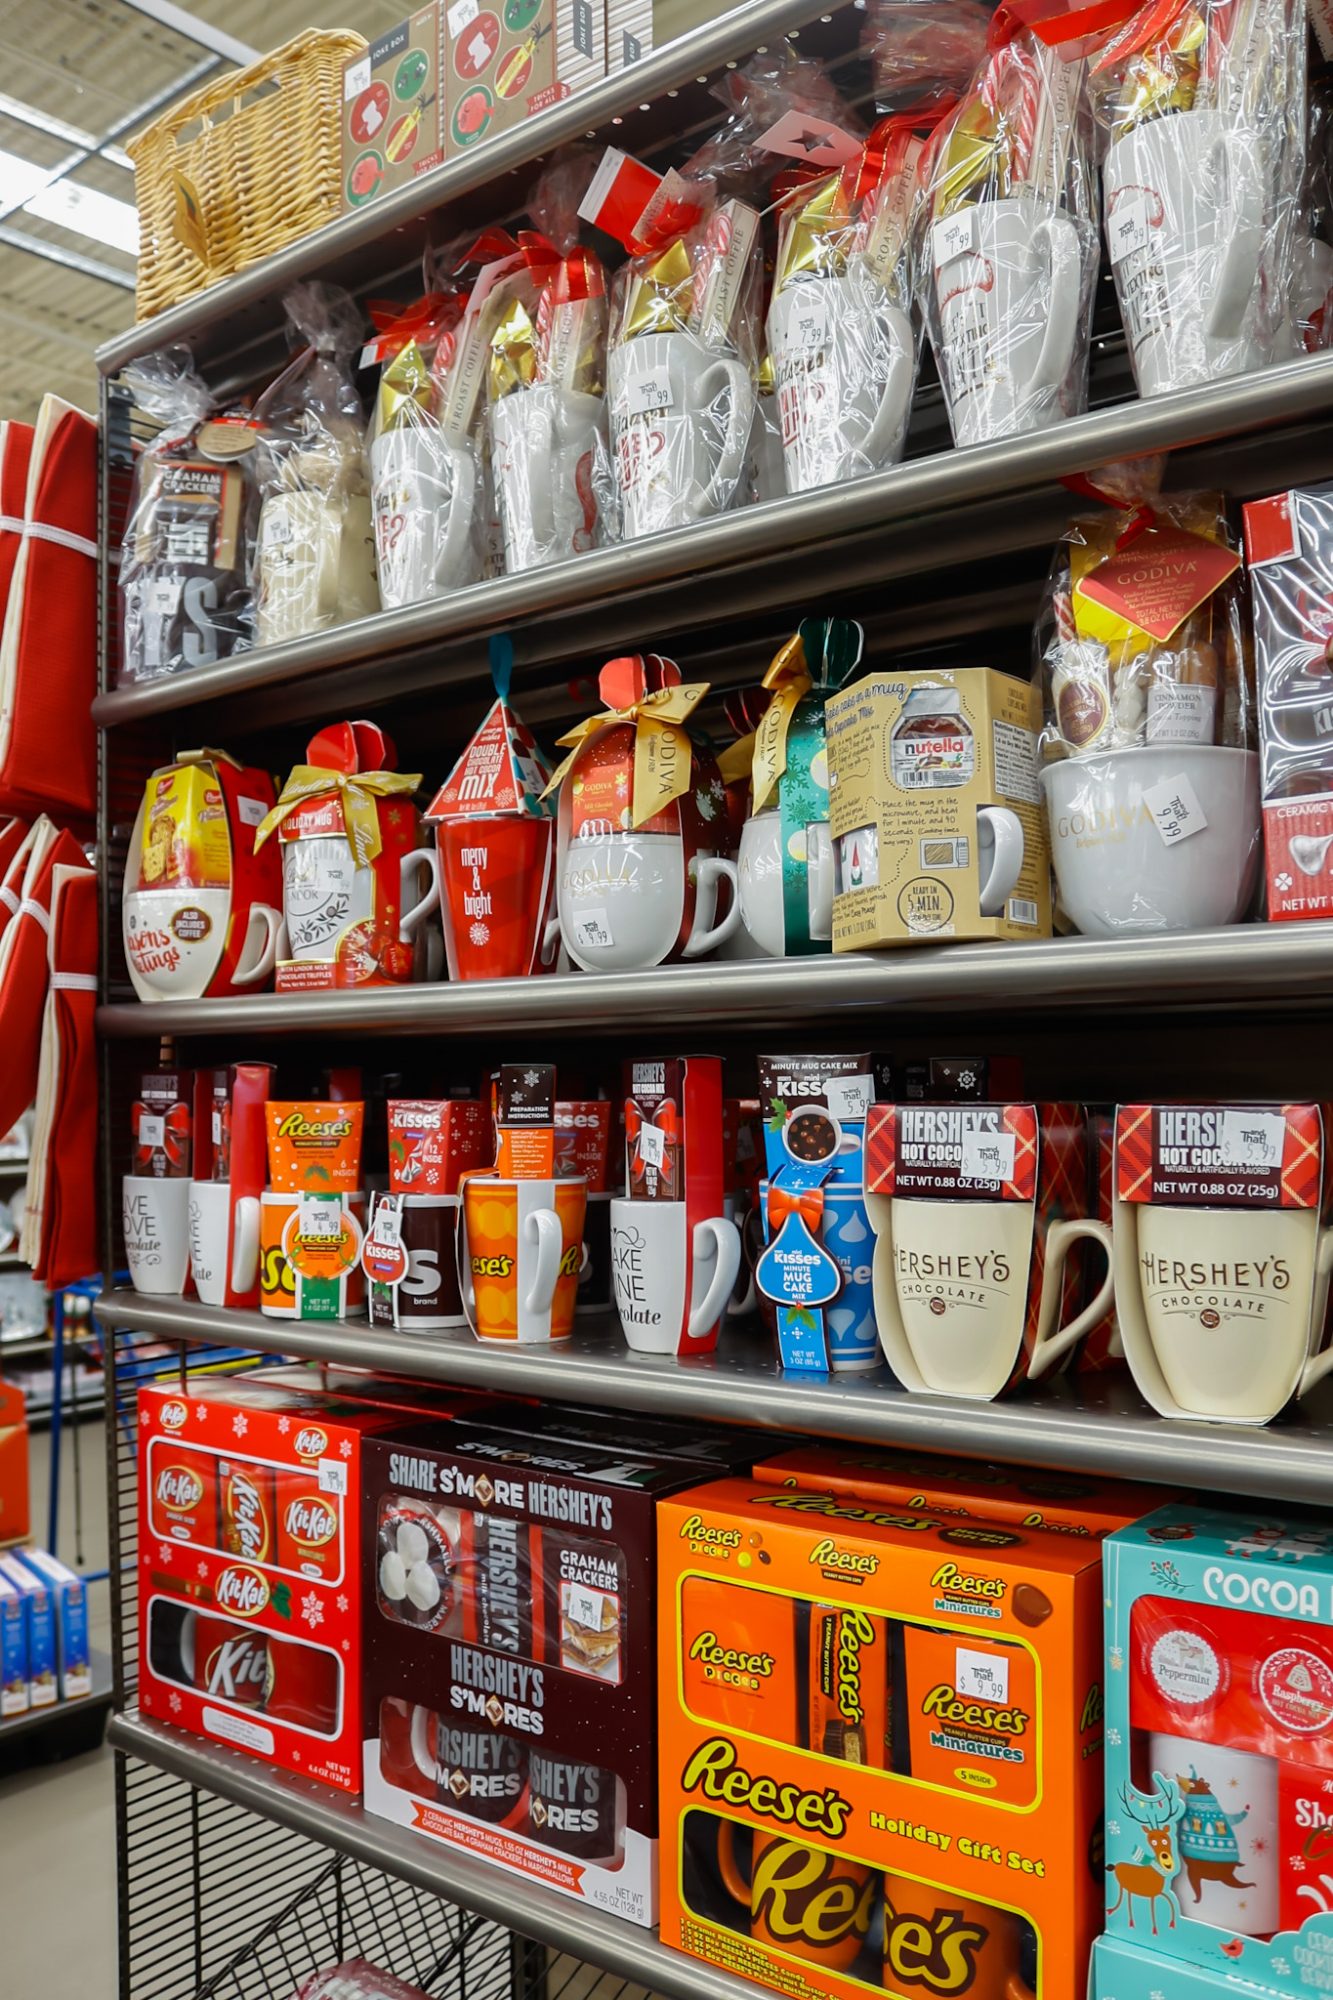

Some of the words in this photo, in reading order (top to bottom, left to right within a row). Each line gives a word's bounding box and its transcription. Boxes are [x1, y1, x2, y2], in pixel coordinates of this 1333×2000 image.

[372, 44, 390, 60] JOKE
[391, 34, 406, 51] BOX
[876, 216, 898, 260] ROAST
[892, 163, 914, 215] COFFEE
[950, 232, 970, 254] 7.99
[716, 283, 731, 321] ROAST
[726, 227, 745, 275] COFFEE
[802, 326, 822, 344] 7.99
[453, 387, 469, 421] ROAST
[466, 338, 483, 382] COFFEE
[162, 471, 222, 485] GRAHAM
[162, 481, 221, 494] CRACKERS
[1117, 561, 1198, 585] GODIVA
[871, 681, 907, 701] mug
[1154, 694, 1202, 702] CINNAMON
[1157, 702, 1196, 711] POWDER
[469, 742, 507, 758] DOUBLE
[905, 738, 964, 755] nutella
[882, 800, 903, 808] Place
[1276, 804, 1326, 819] CERAMIC
[902, 817, 927, 826] minute
[1156, 807, 1182, 838] 9.99
[883, 829, 914, 837] seconds
[461, 847, 488, 870] merry
[472, 867, 481, 891] &
[912, 885, 929, 895] READY
[463, 890, 493, 920] bright
[916, 895, 944, 912] MIN.
[1282, 897, 1305, 912] NET
[1306, 896, 1326, 910] WT
[589, 930, 608, 944] 9.99
[632, 1062, 665, 1083] HERSHEY'S
[770, 1062, 800, 1070] MINUTE
[801, 1062, 819, 1070] MUG
[820, 1062, 841, 1070] CAKE
[842, 1062, 858, 1070] MIX
[278, 1112, 353, 1137] Reese's
[901, 1111, 999, 1144] HERSHEY'S
[1240, 1130, 1267, 1144] That!
[422, 1154, 443, 1164] INSIDE
[429, 1144, 438, 1155] 12
[576, 1152, 603, 1161] INSIDE
[901, 1144, 926, 1160] HOT
[928, 1144, 962, 1161] COCO
[1159, 1147, 1190, 1166] HOT
[1246, 1143, 1277, 1161] 5.99
[332, 1168, 357, 1177] INSIDE
[905, 1159, 933, 1168] NATURALLY
[981, 1159, 1008, 1176] 5.99
[1164, 1165, 1196, 1174] NATURALLY
[1201, 1165, 1238, 1175] ARTIFICIALLY
[1239, 1166, 1271, 1175] FLAVORED
[896, 1175, 916, 1186] NET
[916, 1176, 934, 1187] WT
[934, 1177, 955, 1188] 0.88
[956, 1177, 973, 1189] OZ
[973, 1178, 1001, 1192] (25g)
[1154, 1182, 1177, 1194] NET
[1178, 1182, 1198, 1194] WT
[1199, 1183, 1224, 1195] 0.88
[1227, 1184, 1246, 1196] OZ
[1247, 1184, 1279, 1198] (25g)
[783, 1265, 811, 1273] MINUTE
[892, 1249, 1011, 1283] HERSHEY'S
[1142, 1252, 1291, 1290] HERSHEY'S
[783, 1272, 812, 1283] MUG
[783, 1282, 813, 1293] CAKE
[413, 1297, 438, 1305] brand
[901, 1283, 986, 1304] CHOCOLATE
[1161, 1294, 1266, 1313] CHOCOLATE
[791, 1350, 805, 1358] NET
[390, 1453, 438, 1493] SHARE
[440, 1465, 525, 1509] S'MORE
[528, 1481, 613, 1531] HERSHEY'S
[751, 1493, 944, 1532] Reese's
[680, 1515, 742, 1547] Reese's
[559, 1549, 619, 1576] GRAHAM
[809, 1539, 880, 1574] Reese's
[487, 1518, 521, 1654] HERSHEY'S
[559, 1565, 619, 1592] CRACKERS
[931, 1563, 1007, 1598] Reese's
[1203, 1566, 1319, 1619] COCOA
[934, 1599, 1001, 1618] Miniatures
[690, 1631, 775, 1676] Reese's
[450, 1644, 545, 1708] HERSHEY'S
[839, 1609, 874, 1723] Reese's
[1158, 1664, 1211, 1687] Peppermint
[977, 1679, 1004, 1699] 9.99
[1271, 1684, 1324, 1712] Raspberry
[450, 1685, 545, 1736] S'MORES
[922, 1685, 1029, 1734] Reese's
[931, 1732, 1024, 1762] Miniatures
[944, 1727, 967, 1738] PEANUT
[967, 1732, 990, 1743] BUTTER
[990, 1737, 1006, 1747] CUPS
[960, 1766, 967, 1779] 5
[968, 1773, 992, 1785] INSIDE
[682, 1739, 852, 1837] Reese's
[422, 1817, 454, 1838] CHOCOLATE
[469, 1837, 494, 1854] GRAHAM
[493, 1846, 523, 1866] CRACKERS
[527, 1860, 576, 1887] MARSHMALLOWS
[427, 1811, 454, 1829] CERAMIC
[453, 1819, 485, 1841] HERSHEY'S
[524, 1849, 557, 1870] HERSHEY'S
[557, 1861, 573, 1876] MILK
[870, 1811, 952, 1852] Holiday
[957, 1838, 1003, 1865] Gift
[1008, 1853, 1046, 1878] Set
[593, 1890, 608, 1904] 4.55
[609, 1895, 620, 1909] OZ
[621, 1899, 636, 1915] (128
[615, 1886, 630, 1901] NET
[631, 1892, 644, 1905] WT
[686, 1921, 716, 1938] Ceramic
[717, 1933, 747, 1951] REESE'S
[748, 1946, 769, 1961] Mugs
[721, 1941, 751, 1960] REESE'S
[752, 1953, 779, 1972] PIECES
[780, 1968, 806, 1984] Candy
[722, 1957, 753, 1975] REESE'S
[753, 1971, 782, 1988] Peanut
[738, 1956, 769, 1975] REESE'S
[769, 1970, 799, 1987] Peanut
